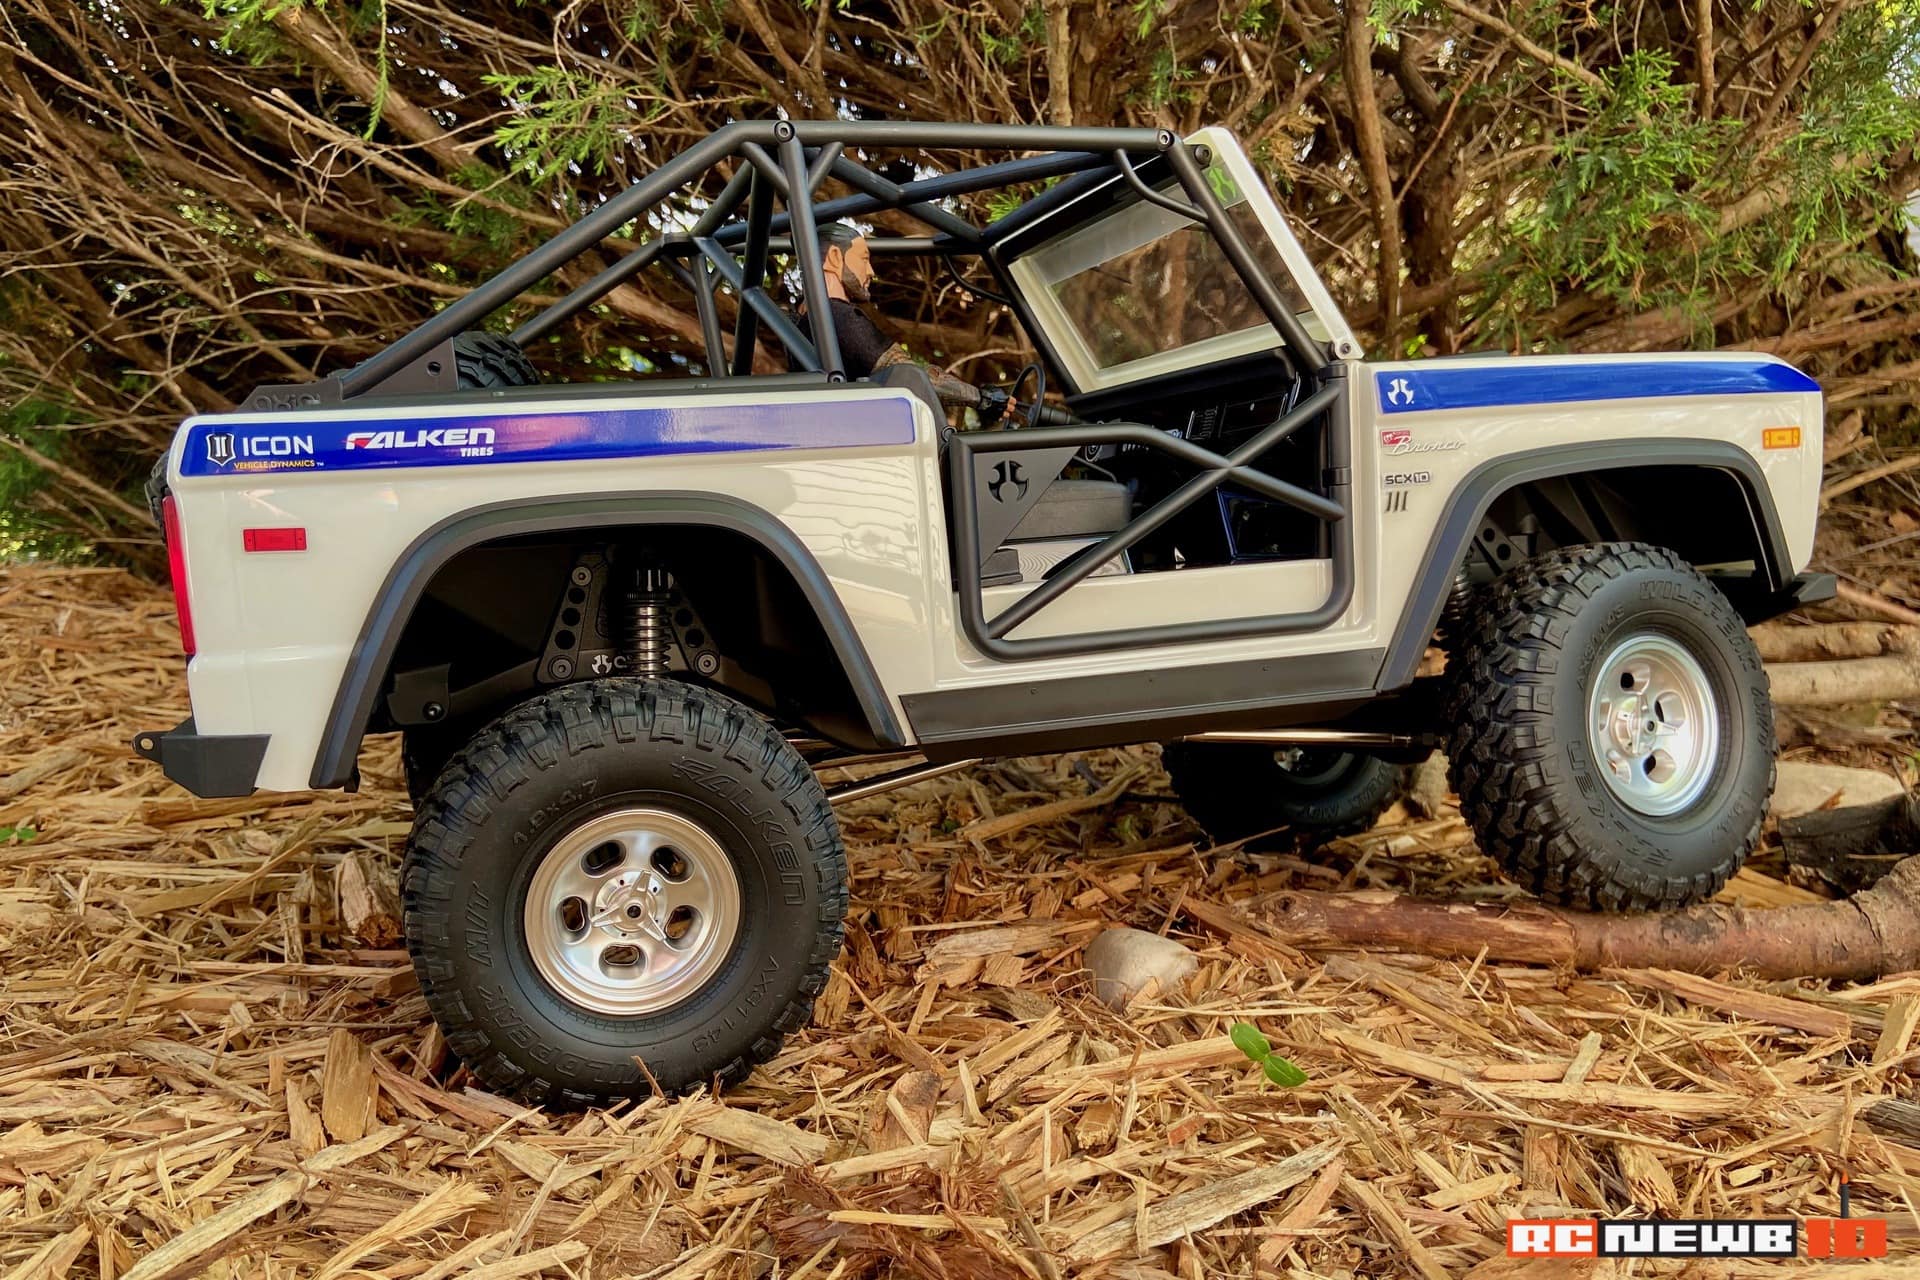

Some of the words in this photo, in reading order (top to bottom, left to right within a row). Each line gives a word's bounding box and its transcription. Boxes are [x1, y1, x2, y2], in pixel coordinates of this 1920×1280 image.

[242, 435, 314, 456] ICON
[345, 427, 495, 450] FALKEN
[460, 447, 494, 457] TIRES
[233, 461, 269, 471] VEHICLE
[270, 459, 315, 469] DYNAMICS
[1385, 471, 1430, 485] SCX10
[670, 757, 807, 906] FALKEN
